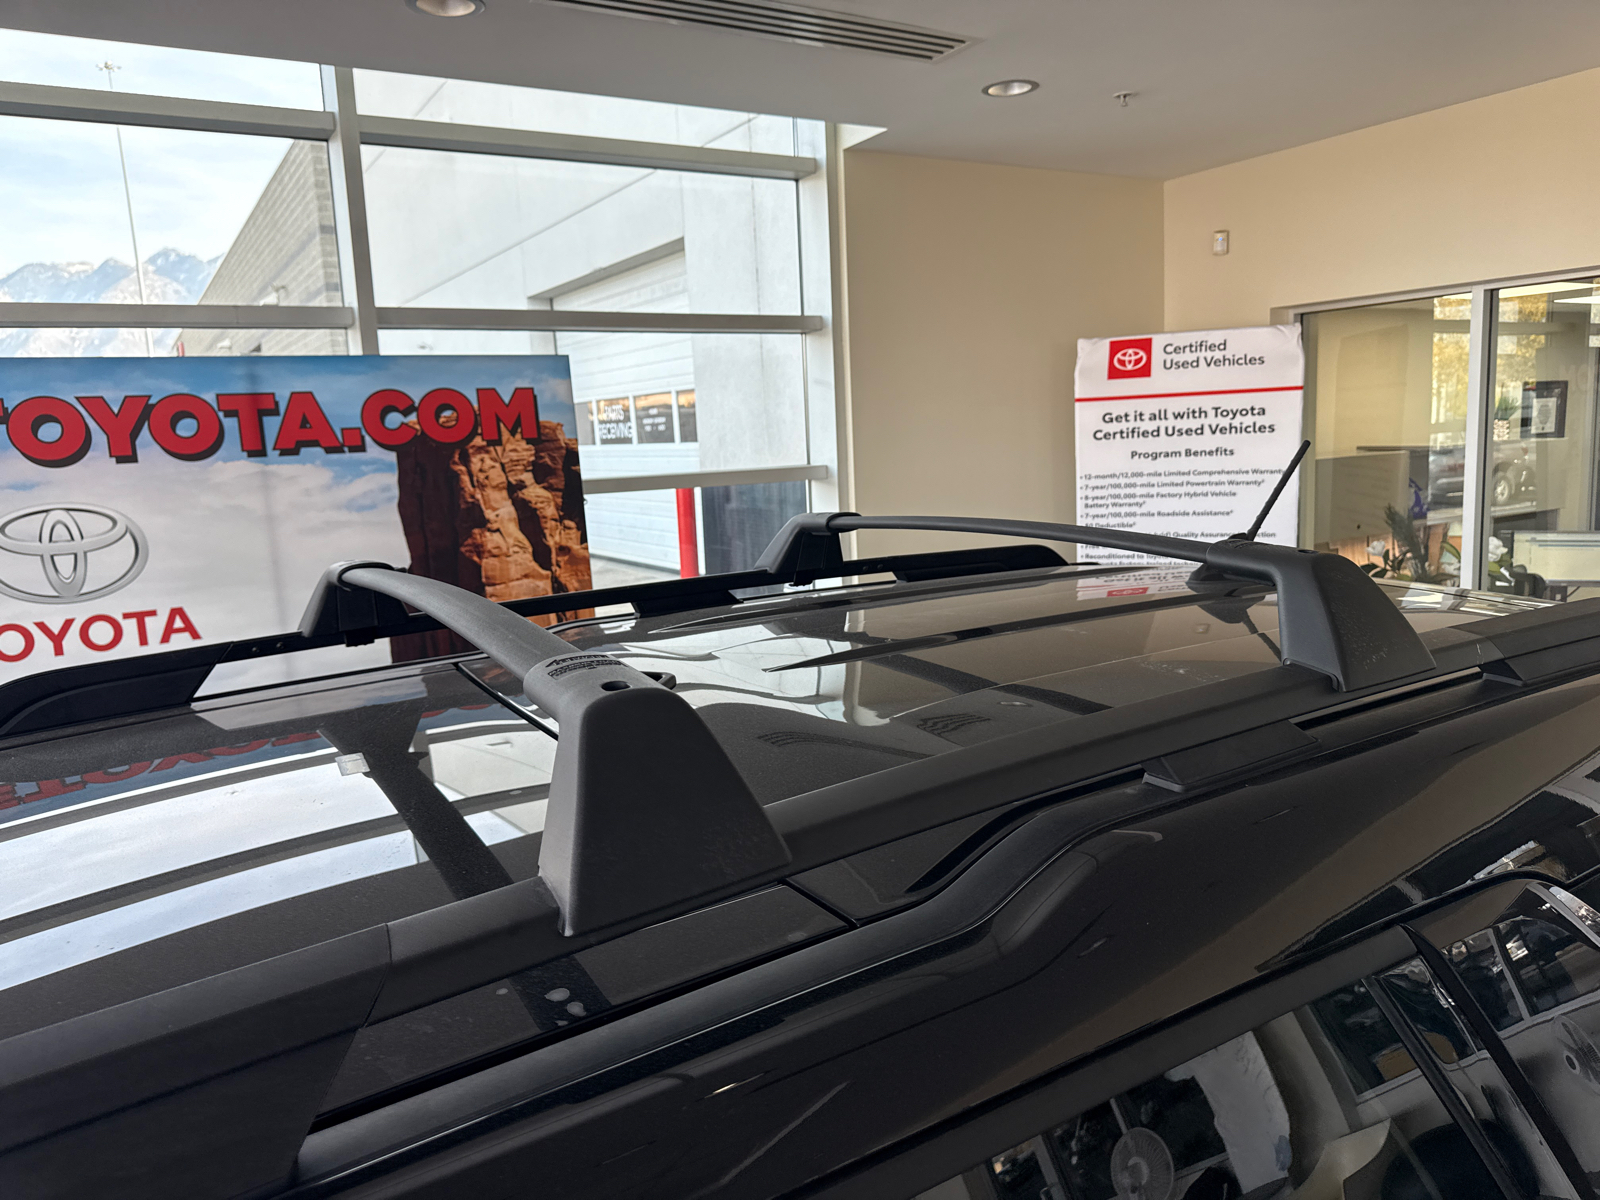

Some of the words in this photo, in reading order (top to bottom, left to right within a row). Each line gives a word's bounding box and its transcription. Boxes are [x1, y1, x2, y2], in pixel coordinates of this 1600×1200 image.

[1163, 339, 1227, 355] Certified
[1163, 356, 1200, 370] Used
[1203, 353, 1265, 368] Vehicles
[1102, 411, 1130, 424] Get
[1133, 410, 1145, 422] it
[1148, 409, 1169, 421] all
[1172, 407, 1208, 420] with
[1211, 405, 1266, 421] Toyota
[0, 387, 542, 468] OYOTA.COM
[1093, 426, 1161, 441] Certified
[1164, 424, 1204, 438] Used
[1208, 421, 1276, 436] Vehicles
[1130, 449, 1181, 461] Program
[1184, 446, 1235, 458] Benefits
[1163, 469, 1191, 477] Limited
[1192, 468, 1250, 477] Comprehensive
[1157, 480, 1184, 488] Limited
[1185, 479, 1226, 487] Powertrain
[1156, 491, 1182, 499] Factory
[1184, 490, 1208, 499] Hybrid
[1084, 502, 1109, 510] Battery
[1157, 509, 1190, 517] Roadside
[1172, 531, 1199, 539] Quality
[1200, 530, 1232, 538] Assuranc
